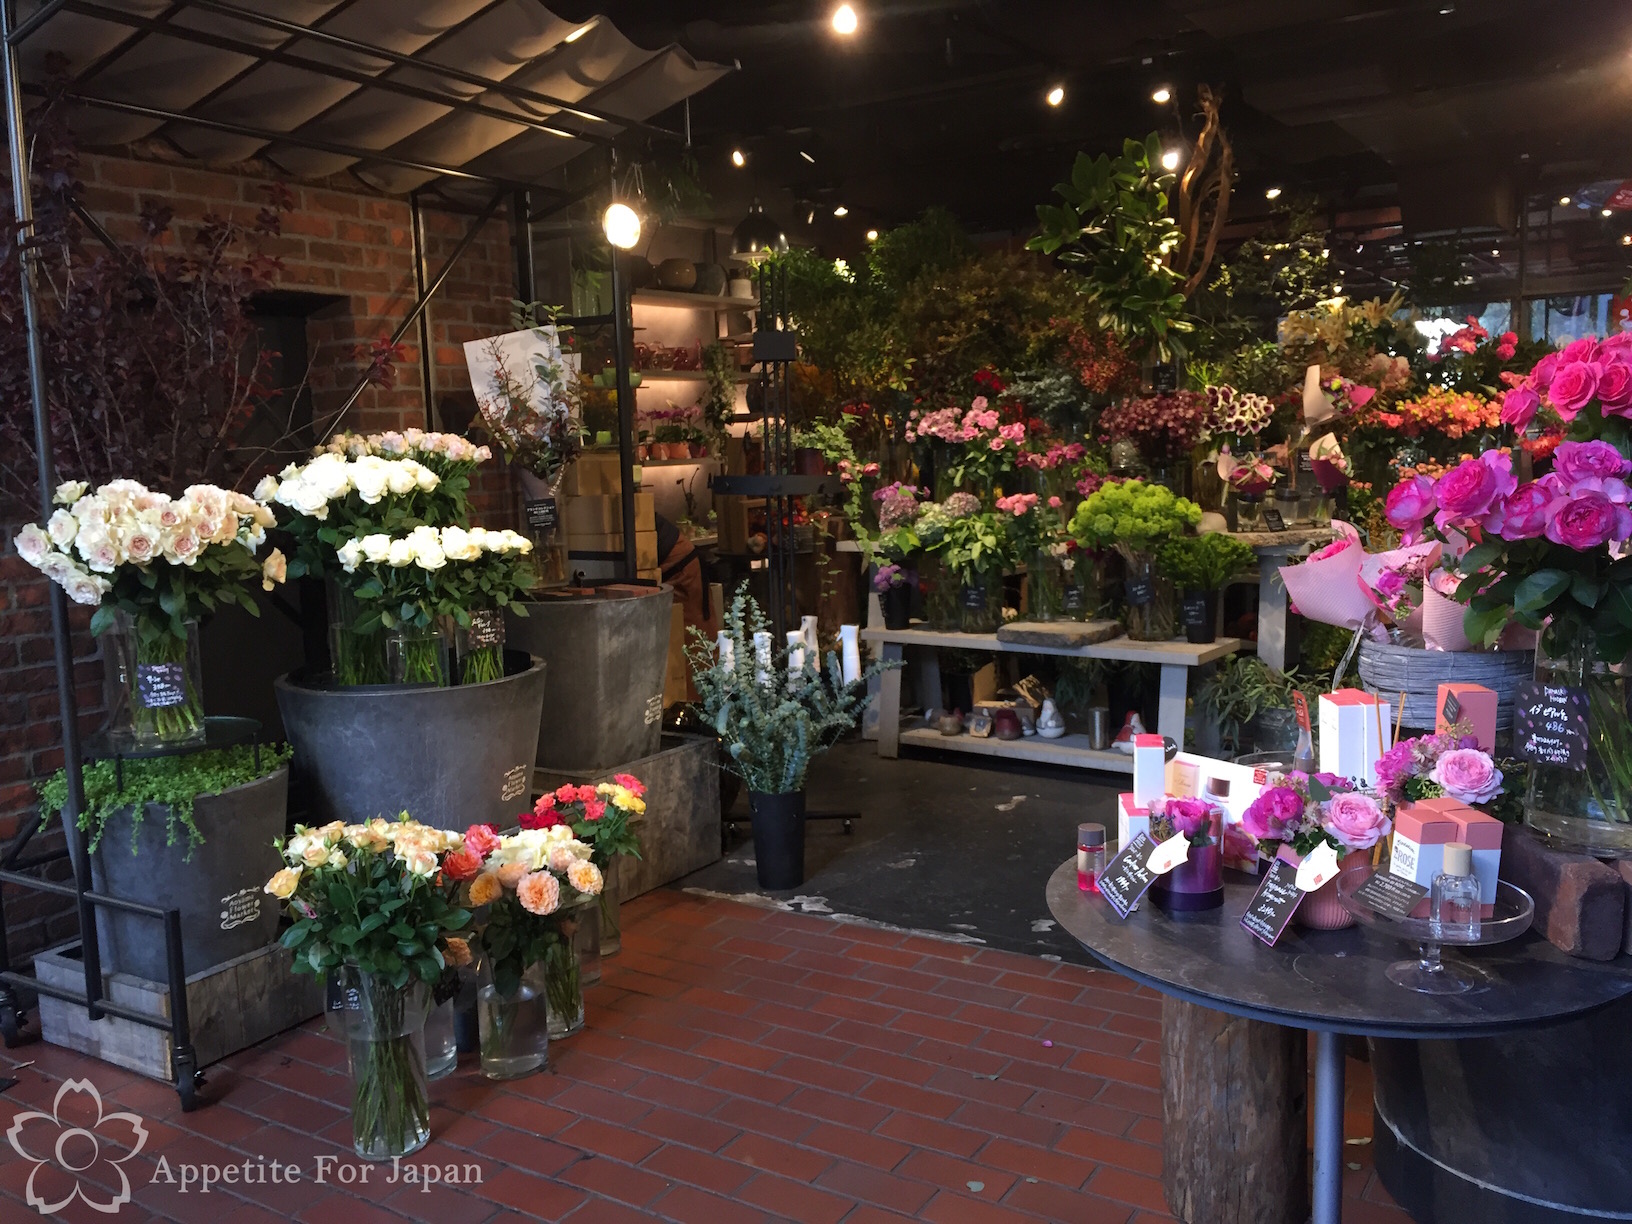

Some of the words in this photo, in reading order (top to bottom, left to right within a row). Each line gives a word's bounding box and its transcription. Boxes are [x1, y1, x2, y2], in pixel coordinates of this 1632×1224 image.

[1545, 721, 1565, 733] 486
[1397, 852, 1415, 870] ROSE
[230, 901, 254, 914] Flower
[230, 908, 254, 920] Market
